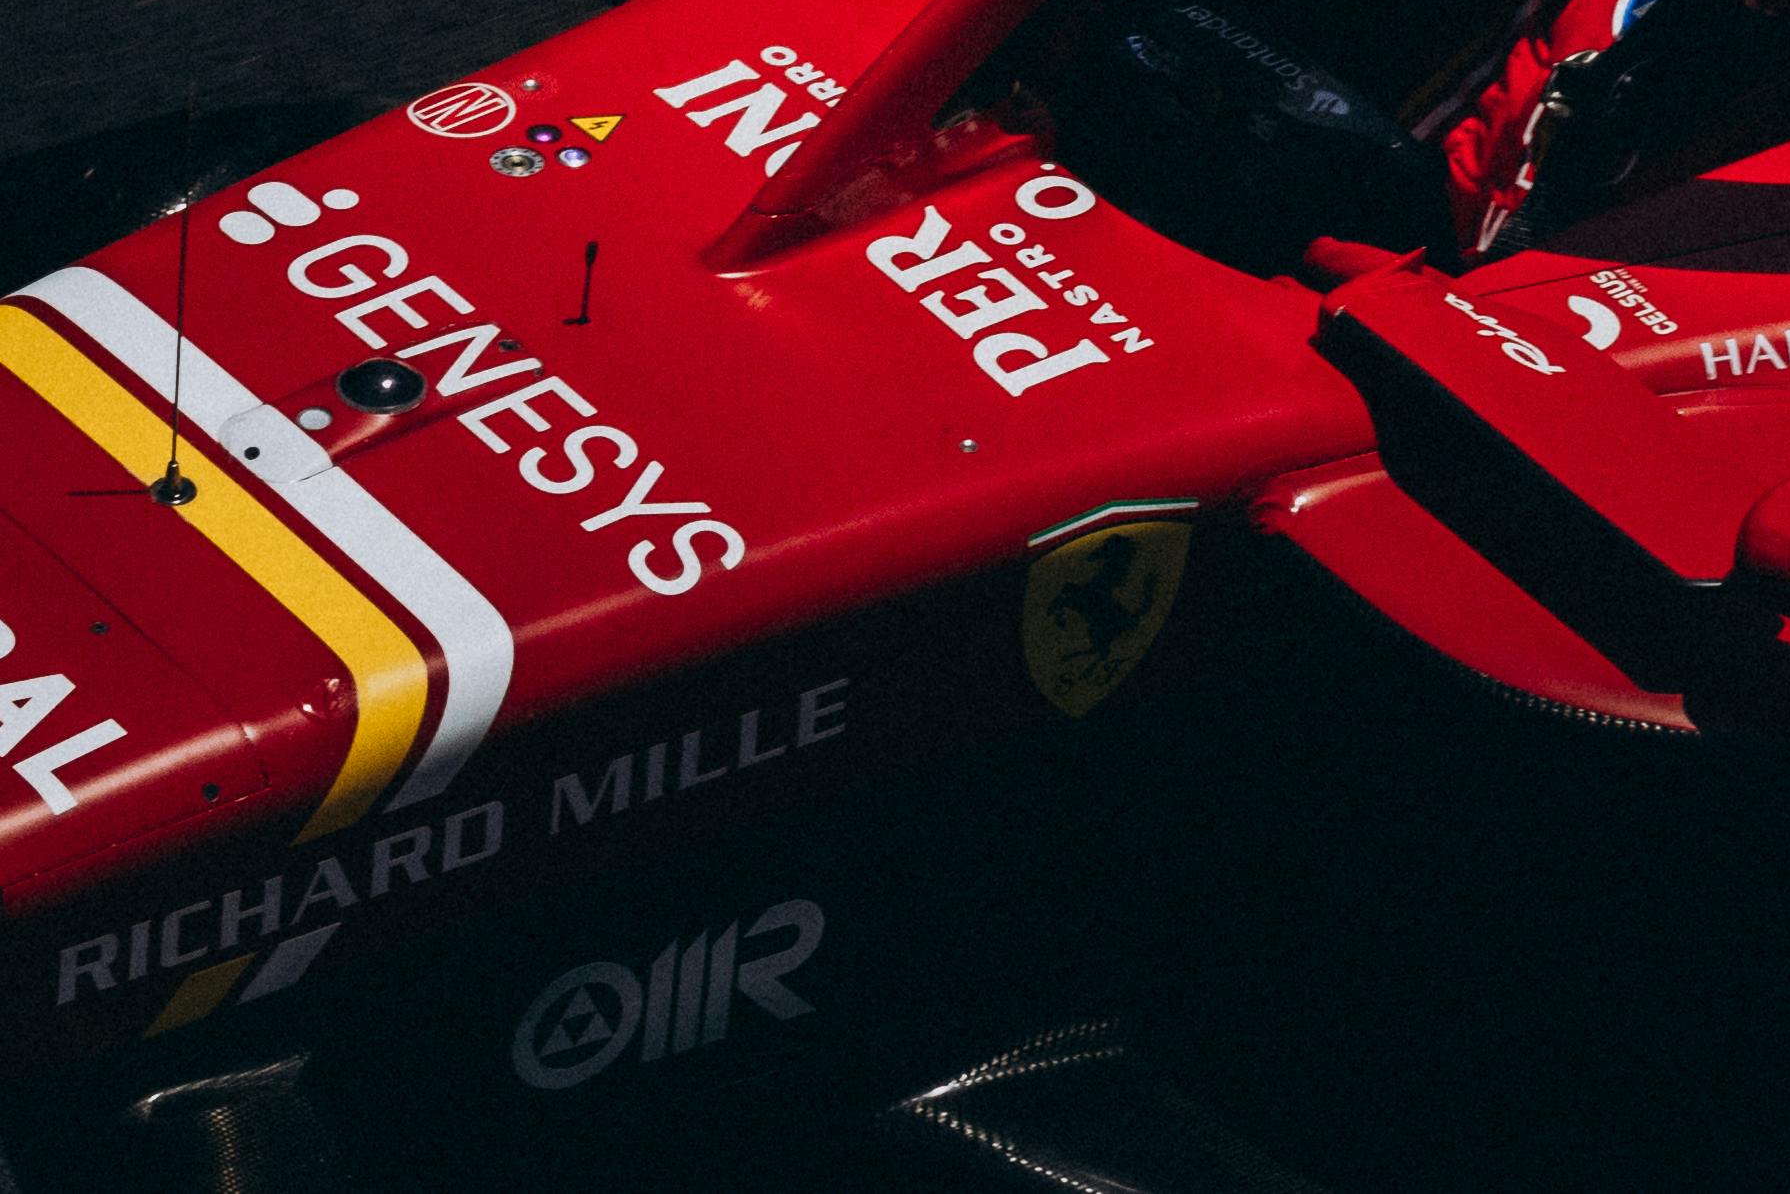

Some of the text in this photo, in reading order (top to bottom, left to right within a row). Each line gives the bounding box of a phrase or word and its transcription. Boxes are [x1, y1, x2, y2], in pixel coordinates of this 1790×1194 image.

[988, 222, 1155, 354] NASTRO
[1589, 270, 1679, 335] CELSIUS
[287, 233, 747, 597] GENESYS
[0, 619, 129, 816] AL
[55, 676, 852, 1007] RICHARD MILLE
